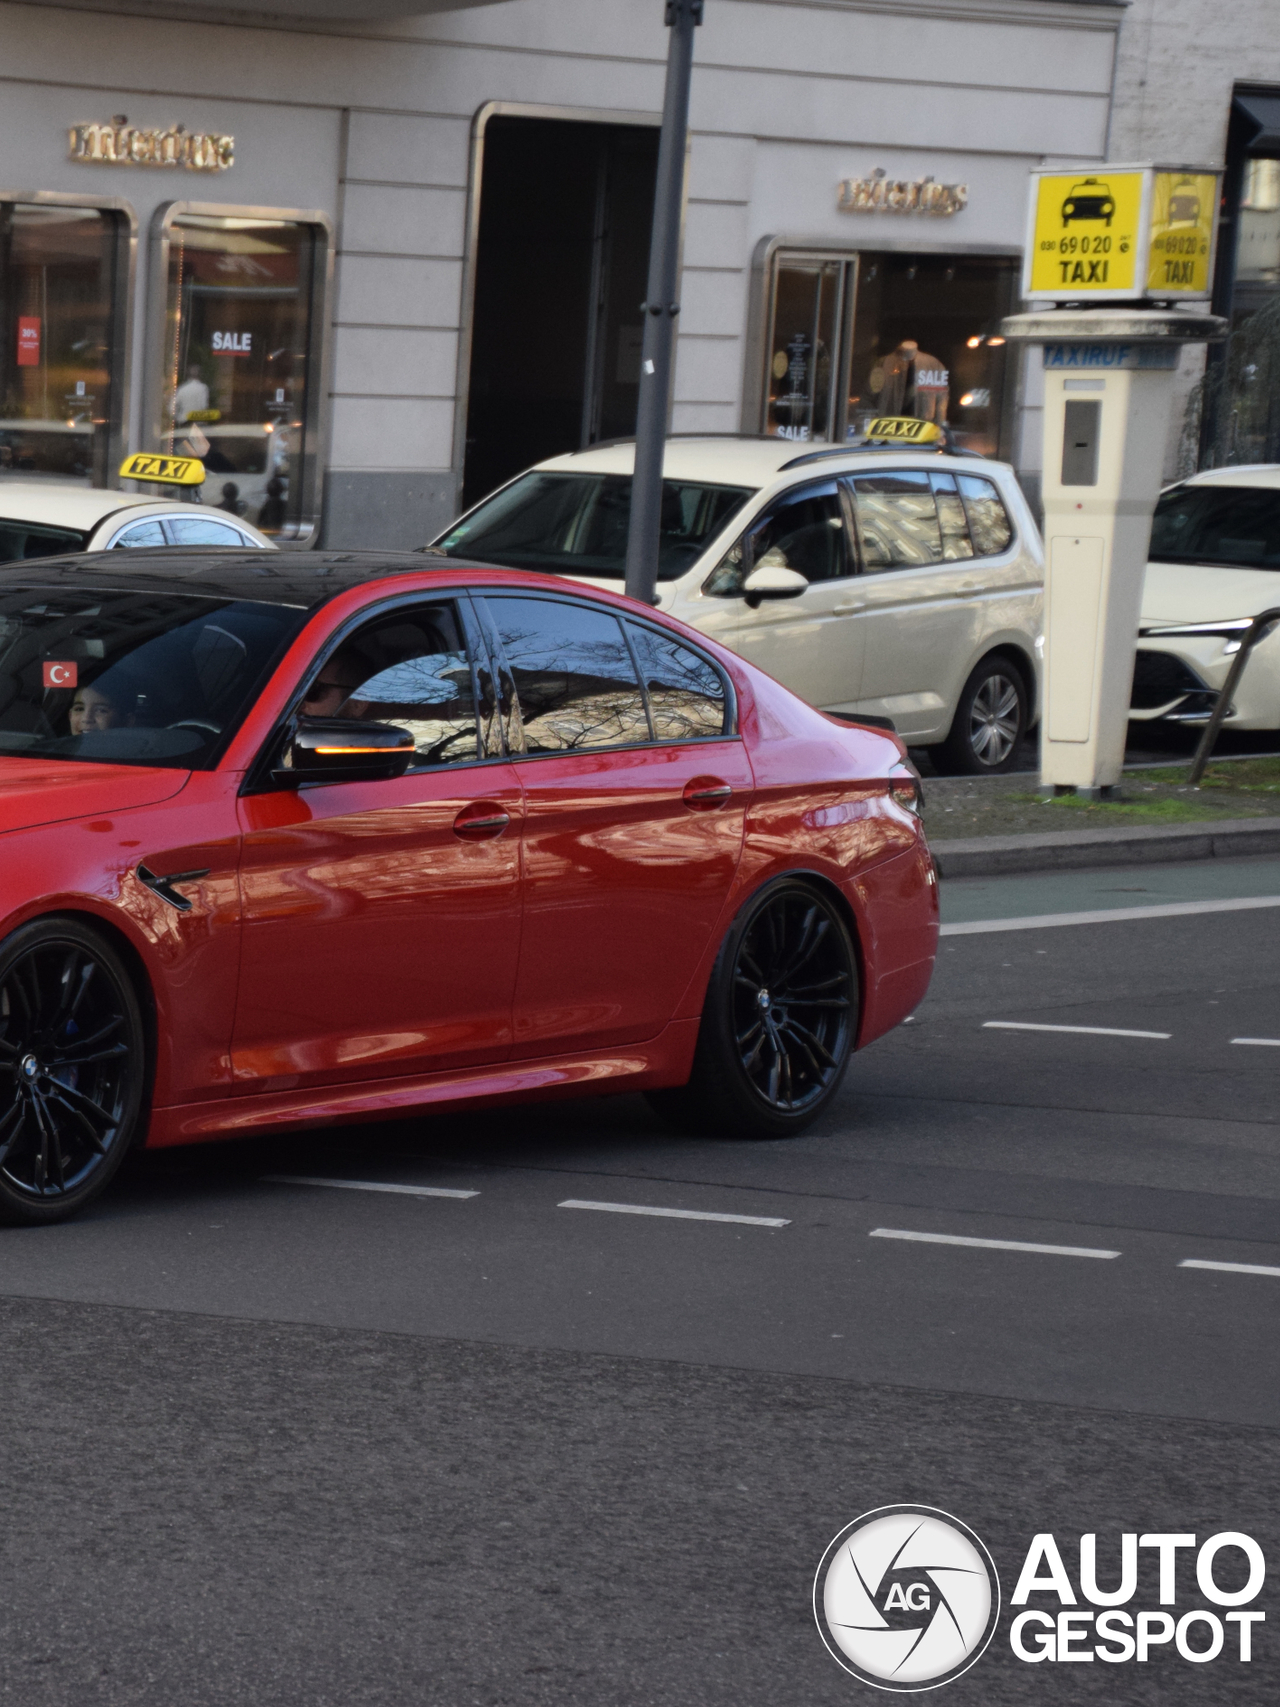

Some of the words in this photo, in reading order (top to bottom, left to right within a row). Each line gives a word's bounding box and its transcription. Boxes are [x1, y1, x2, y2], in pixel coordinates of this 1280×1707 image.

[1040, 241, 1057, 251] 030
[1059, 260, 1110, 284] TAXI
[1165, 260, 1195, 284] TAXI
[22, 328, 38, 339] 30%
[212, 331, 252, 351] SALE
[1043, 345, 1132, 366] TAXIRUF
[918, 369, 949, 386] SALE
[777, 425, 809, 442] SALE
[876, 420, 921, 437] TAXI
[136, 457, 188, 478] TAXI
